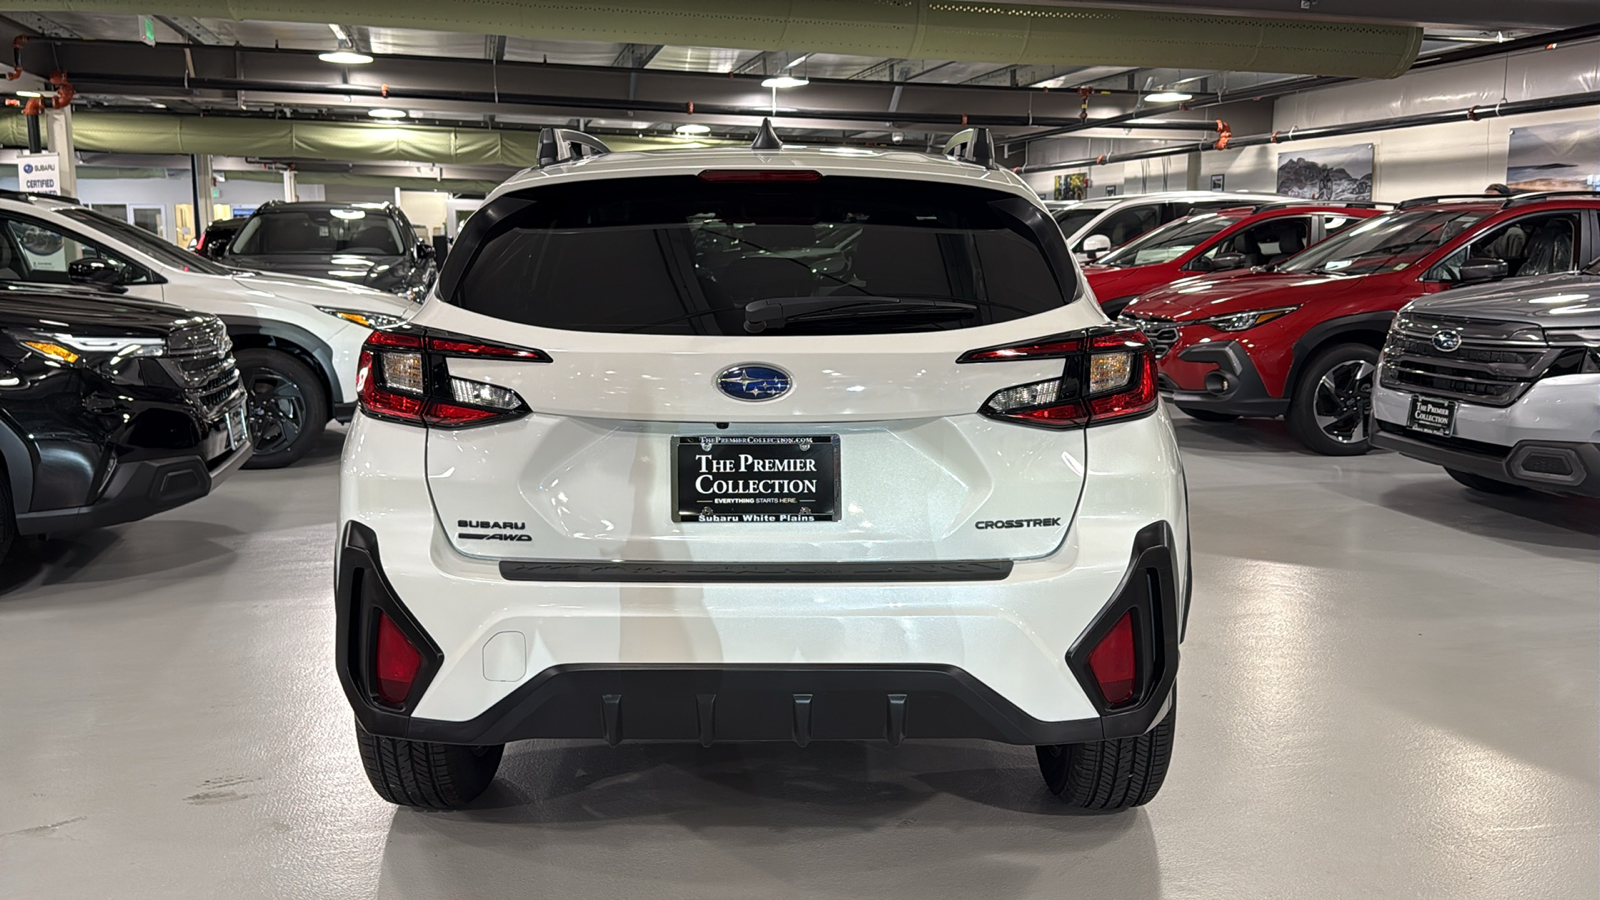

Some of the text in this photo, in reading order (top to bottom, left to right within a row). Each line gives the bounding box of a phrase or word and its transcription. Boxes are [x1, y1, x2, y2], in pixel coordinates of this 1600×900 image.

[34, 164, 55, 172] SUBARU
[26, 179, 55, 189] CERTIFIED
[695, 453, 817, 473] THE PREMIER
[695, 474, 817, 494] COLLECTION
[698, 514, 815, 522] Subaru White Plains
[974, 516, 1062, 530] CROSSTREK
[457, 519, 526, 530] SUBARU
[486, 533, 533, 542] AWD
